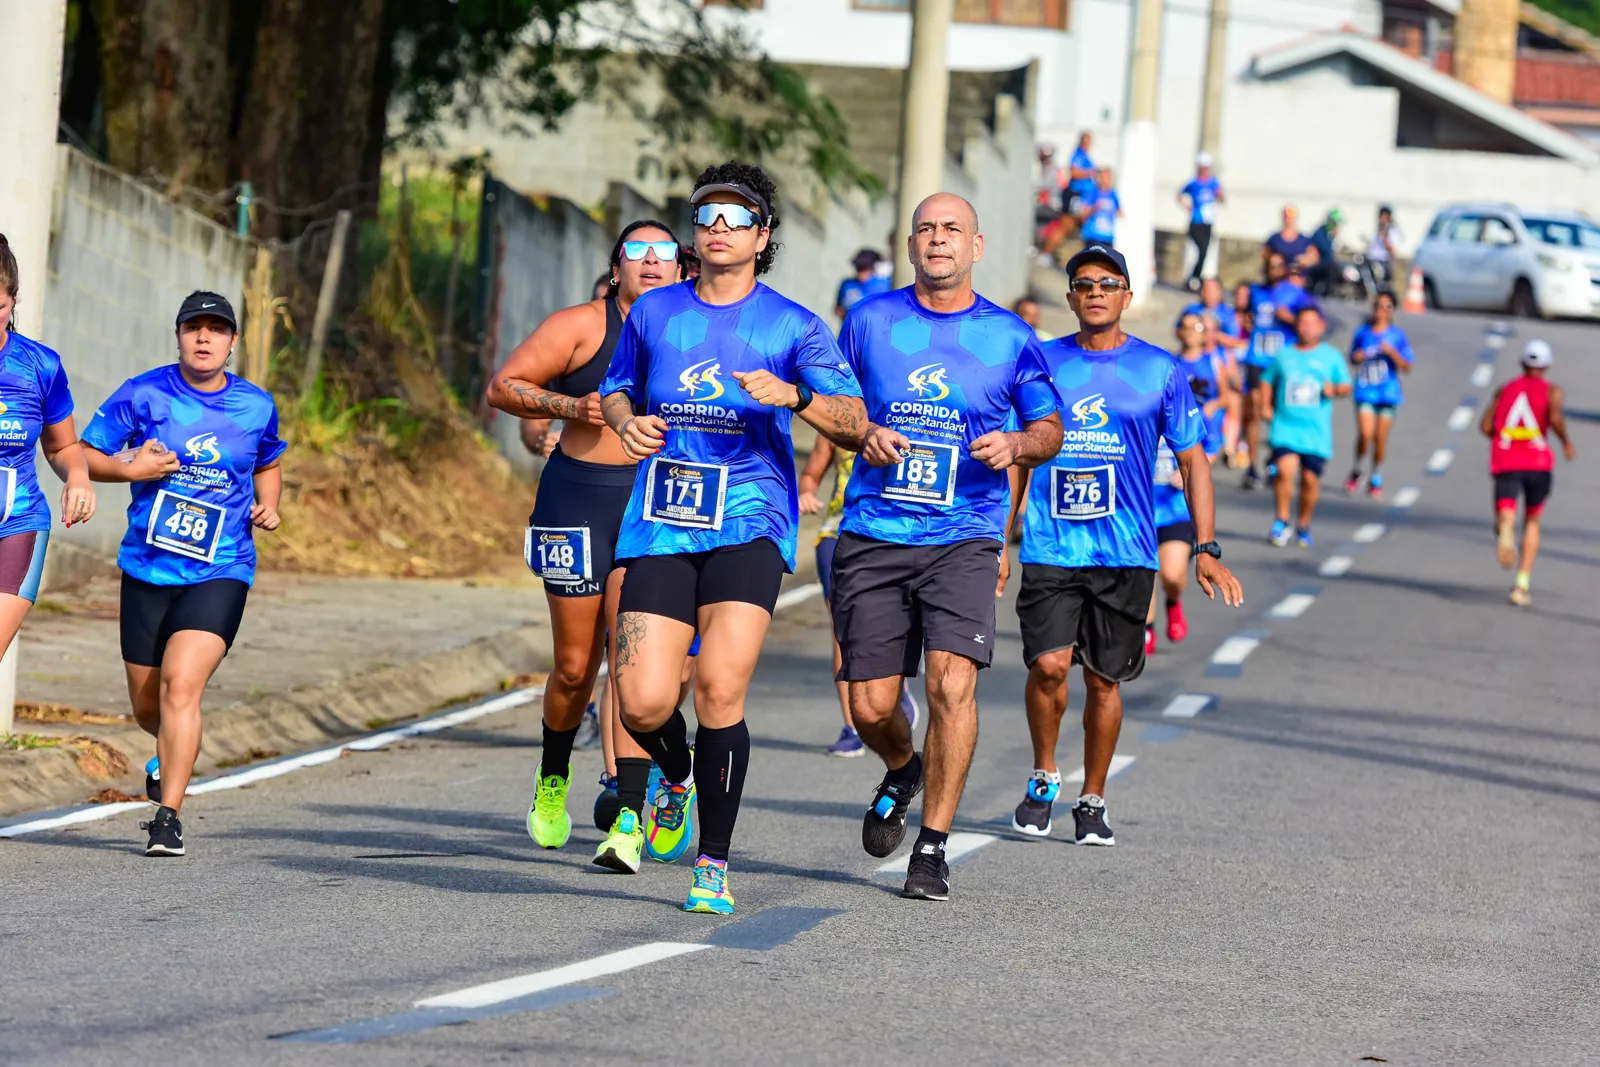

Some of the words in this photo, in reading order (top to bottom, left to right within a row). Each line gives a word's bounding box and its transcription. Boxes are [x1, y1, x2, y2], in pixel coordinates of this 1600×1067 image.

[660, 402, 738, 421] CORRIDA
[890, 401, 960, 421] CORRIDA
[886, 413, 967, 433] CooperStandard
[180, 465, 229, 480] ORRIDA
[896, 458, 939, 486] 183
[664, 479, 704, 507] 171
[907, 482, 919, 492] ARI
[1063, 481, 1102, 504] 276
[666, 503, 696, 516] ANDRESSA
[165, 511, 208, 541] 458
[537, 544, 575, 568] 148
[565, 582, 599, 594] RUN
